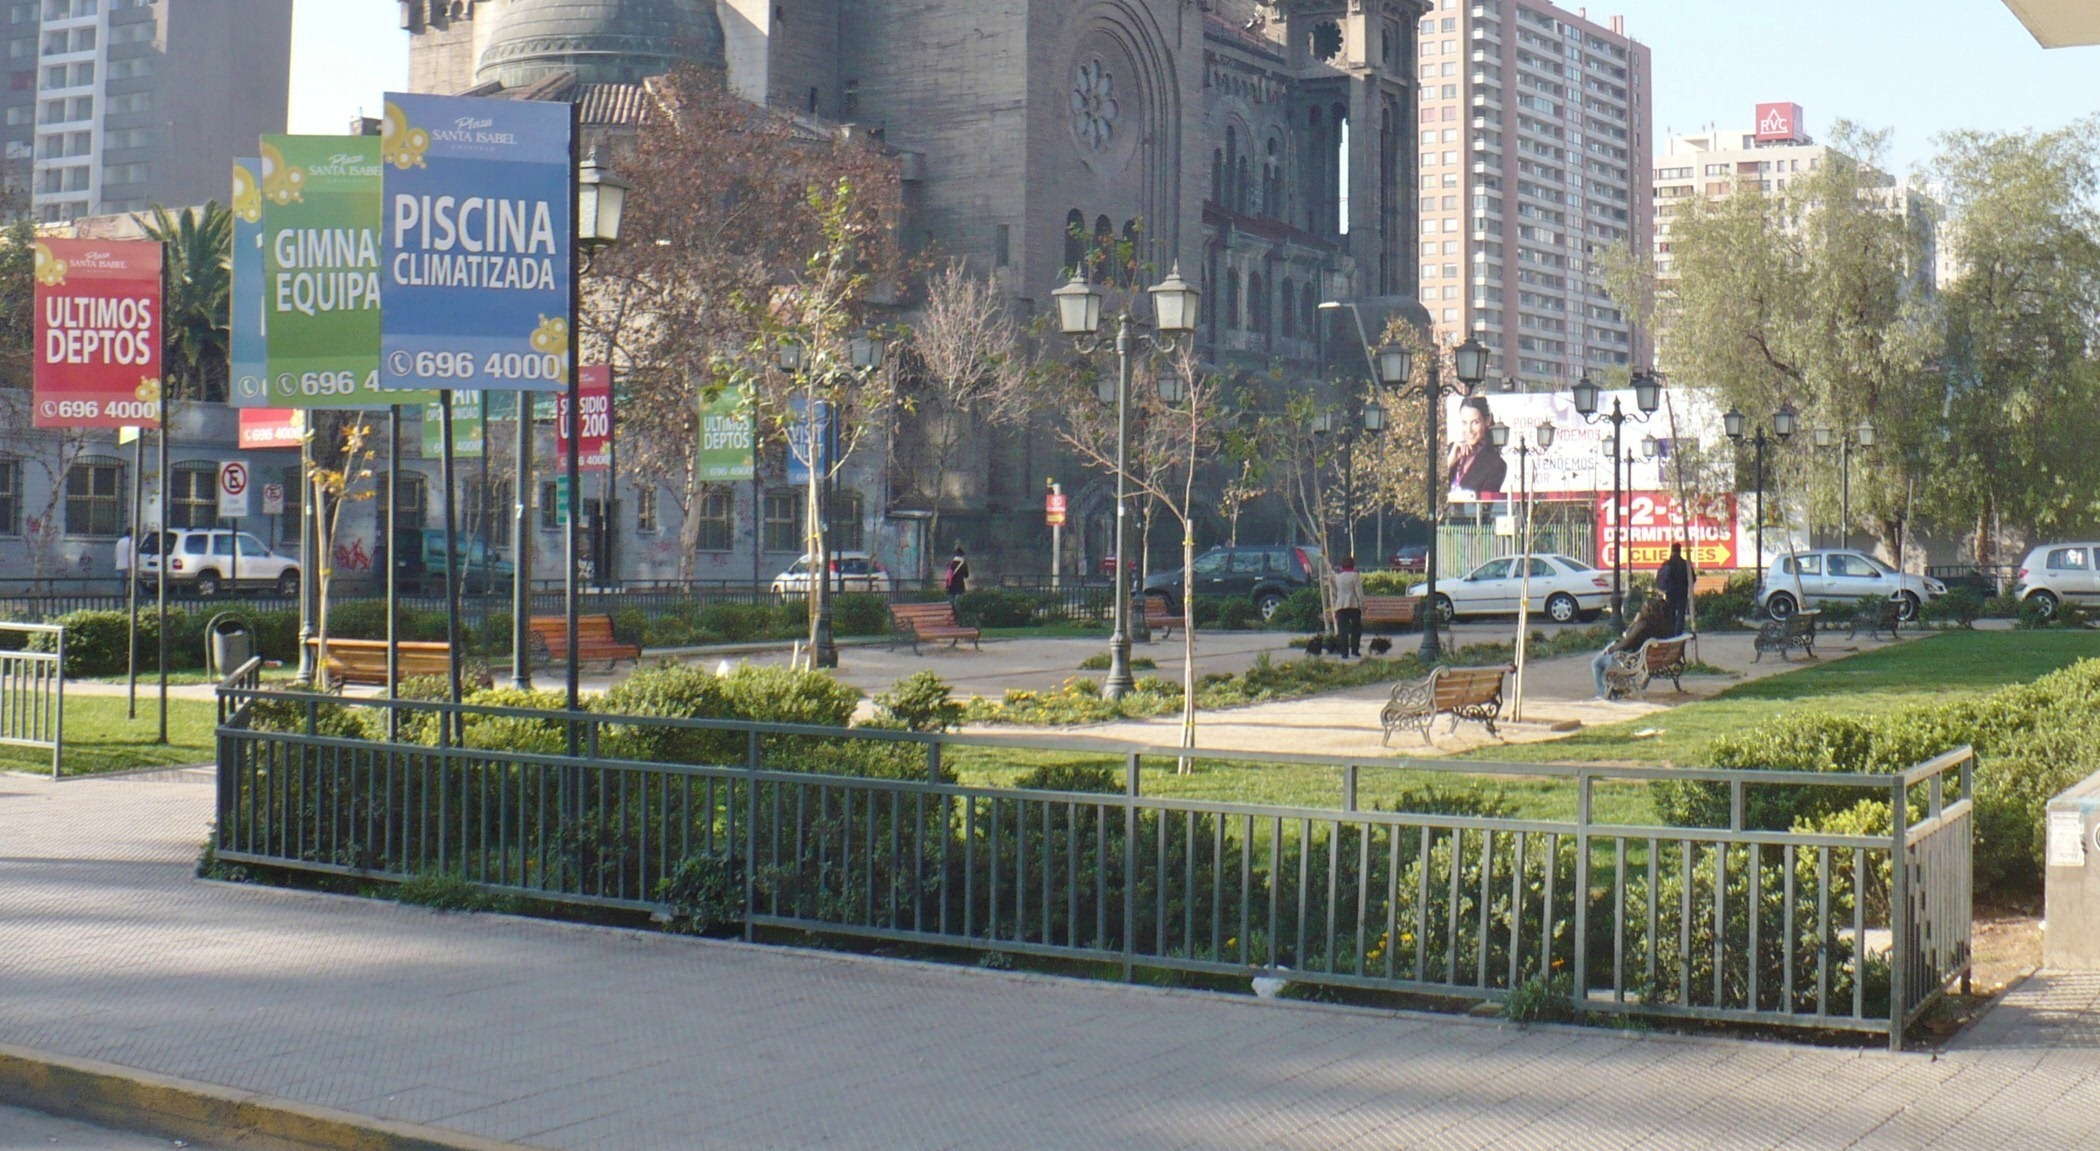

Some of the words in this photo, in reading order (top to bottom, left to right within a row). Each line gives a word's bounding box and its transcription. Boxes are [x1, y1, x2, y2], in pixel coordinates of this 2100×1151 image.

[455, 117, 493, 131] Plaza
[1760, 118, 1788, 133] RVC
[432, 129, 472, 142] SANTA
[476, 132, 518, 145] ISABEL
[309, 165, 346, 176] SANTA
[394, 194, 556, 255] PISCINA
[274, 228, 382, 269] GIMNA
[393, 252, 555, 290] CLIMATIZADA
[46, 297, 151, 329] ULTIMOS
[46, 329, 151, 365] DEPTOS
[415, 351, 474, 379] 696
[484, 352, 561, 380] 4000
[301, 371, 355, 396] 696
[59, 401, 98, 418] 696
[104, 401, 155, 418] 4000
[252, 428, 273, 440] 696
[581, 413, 608, 437] 200
[704, 431, 750, 450] DEPTOS
[1603, 525, 1731, 542] DORMITORIOS
